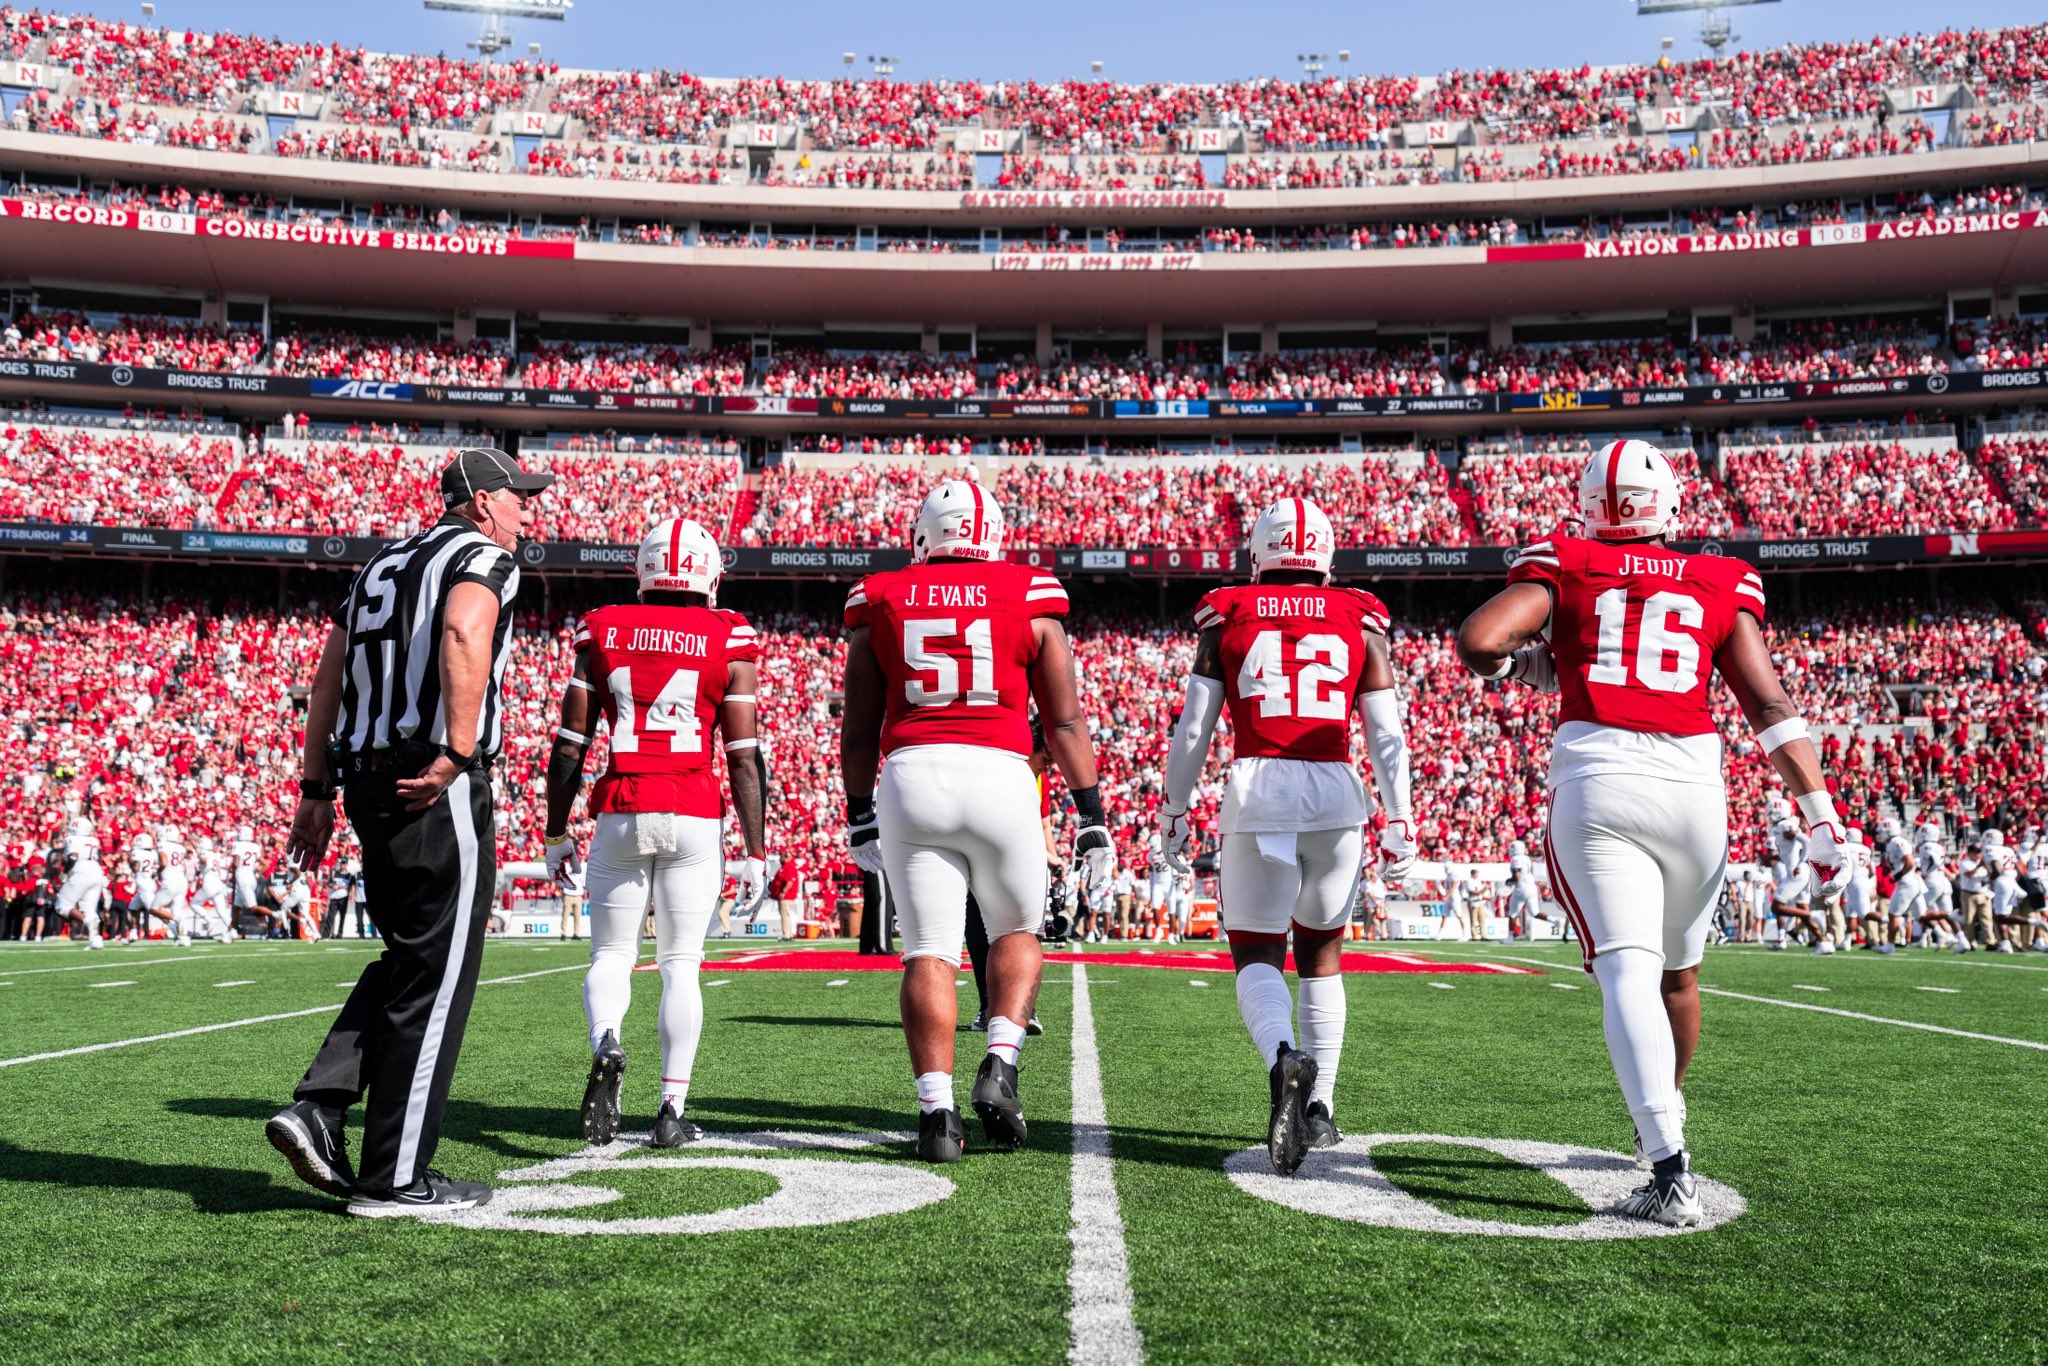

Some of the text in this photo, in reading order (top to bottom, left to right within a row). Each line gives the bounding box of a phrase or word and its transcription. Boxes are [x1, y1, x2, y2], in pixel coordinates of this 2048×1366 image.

[20, 67, 38, 81] N
[283, 96, 299, 110] N
[1916, 89, 1934, 105] N
[527, 116, 541, 129] N
[1666, 112, 1681, 125] N
[759, 128, 773, 141] N
[1203, 132, 1217, 145] N
[1430, 126, 1444, 138] N
[984, 134, 998, 146] N
[963, 191, 1226, 208] NATIONAL CHAMPIONSHIPS
[21, 201, 128, 227] RECORD
[142, 213, 188, 230] 401
[206, 218, 380, 247] CONSECUTIVE
[393, 233, 507, 256] SELLOUTS
[1584, 237, 1678, 258] NATION
[1690, 230, 1799, 252] LEADING
[1818, 227, 1861, 241] 108
[1878, 212, 2020, 239] ACADEMIC
[33, 364, 77, 379] TRUST
[168, 374, 268, 391] BRIDGES TRUST
[1982, 371, 2040, 387] BRIDGES
[332, 381, 399, 399] ACC
[1712, 389, 1721, 399] 0
[1806, 384, 1813, 395] 7
[1840, 382, 1887, 394] GEORGIA
[448, 391, 472, 401] WAKE
[473, 392, 504, 402] FOREST
[511, 392, 526, 402] 34
[549, 394, 677, 409] FINAL 30 NC STATE
[1644, 392, 1684, 403] AUBURN
[850, 403, 886, 413] BAYLOR
[1021, 404, 1044, 414] IOWA
[1241, 403, 1267, 414] UCLA
[1337, 402, 1365, 411] FINAL
[1388, 400, 1401, 410] 27
[1413, 401, 1437, 411] PENN
[1438, 400, 1464, 411] STATE
[69, 530, 87, 541] 34
[122, 533, 156, 544] FINAL
[189, 535, 205, 547] 24
[215, 538, 243, 549] NORTH
[243, 540, 284, 551] CAROLINA
[1949, 534, 1979, 555] N
[580, 549, 635, 562] BRIDGES
[954, 547, 990, 559] HUSKERS
[1759, 542, 1869, 558] BRIDGES TRUST
[771, 552, 871, 566] BRIDGES TRUST
[1029, 552, 1040, 566] 0
[1169, 552, 1180, 566] 0
[1280, 559, 1317, 568] HUSKERS
[1366, 552, 1468, 566] BRIDGES TRUST
[654, 579, 690, 589] HUSKERS
[905, 584, 987, 607] J. EVANS
[1257, 596, 1326, 618] GBAYOR
[605, 627, 708, 657] R. JOHNSON
[1588, 588, 1704, 694] 16
[903, 618, 999, 707] 51
[1237, 630, 1349, 720] 42
[606, 665, 702, 753] 14
[1154, 862, 1169, 873] 22
